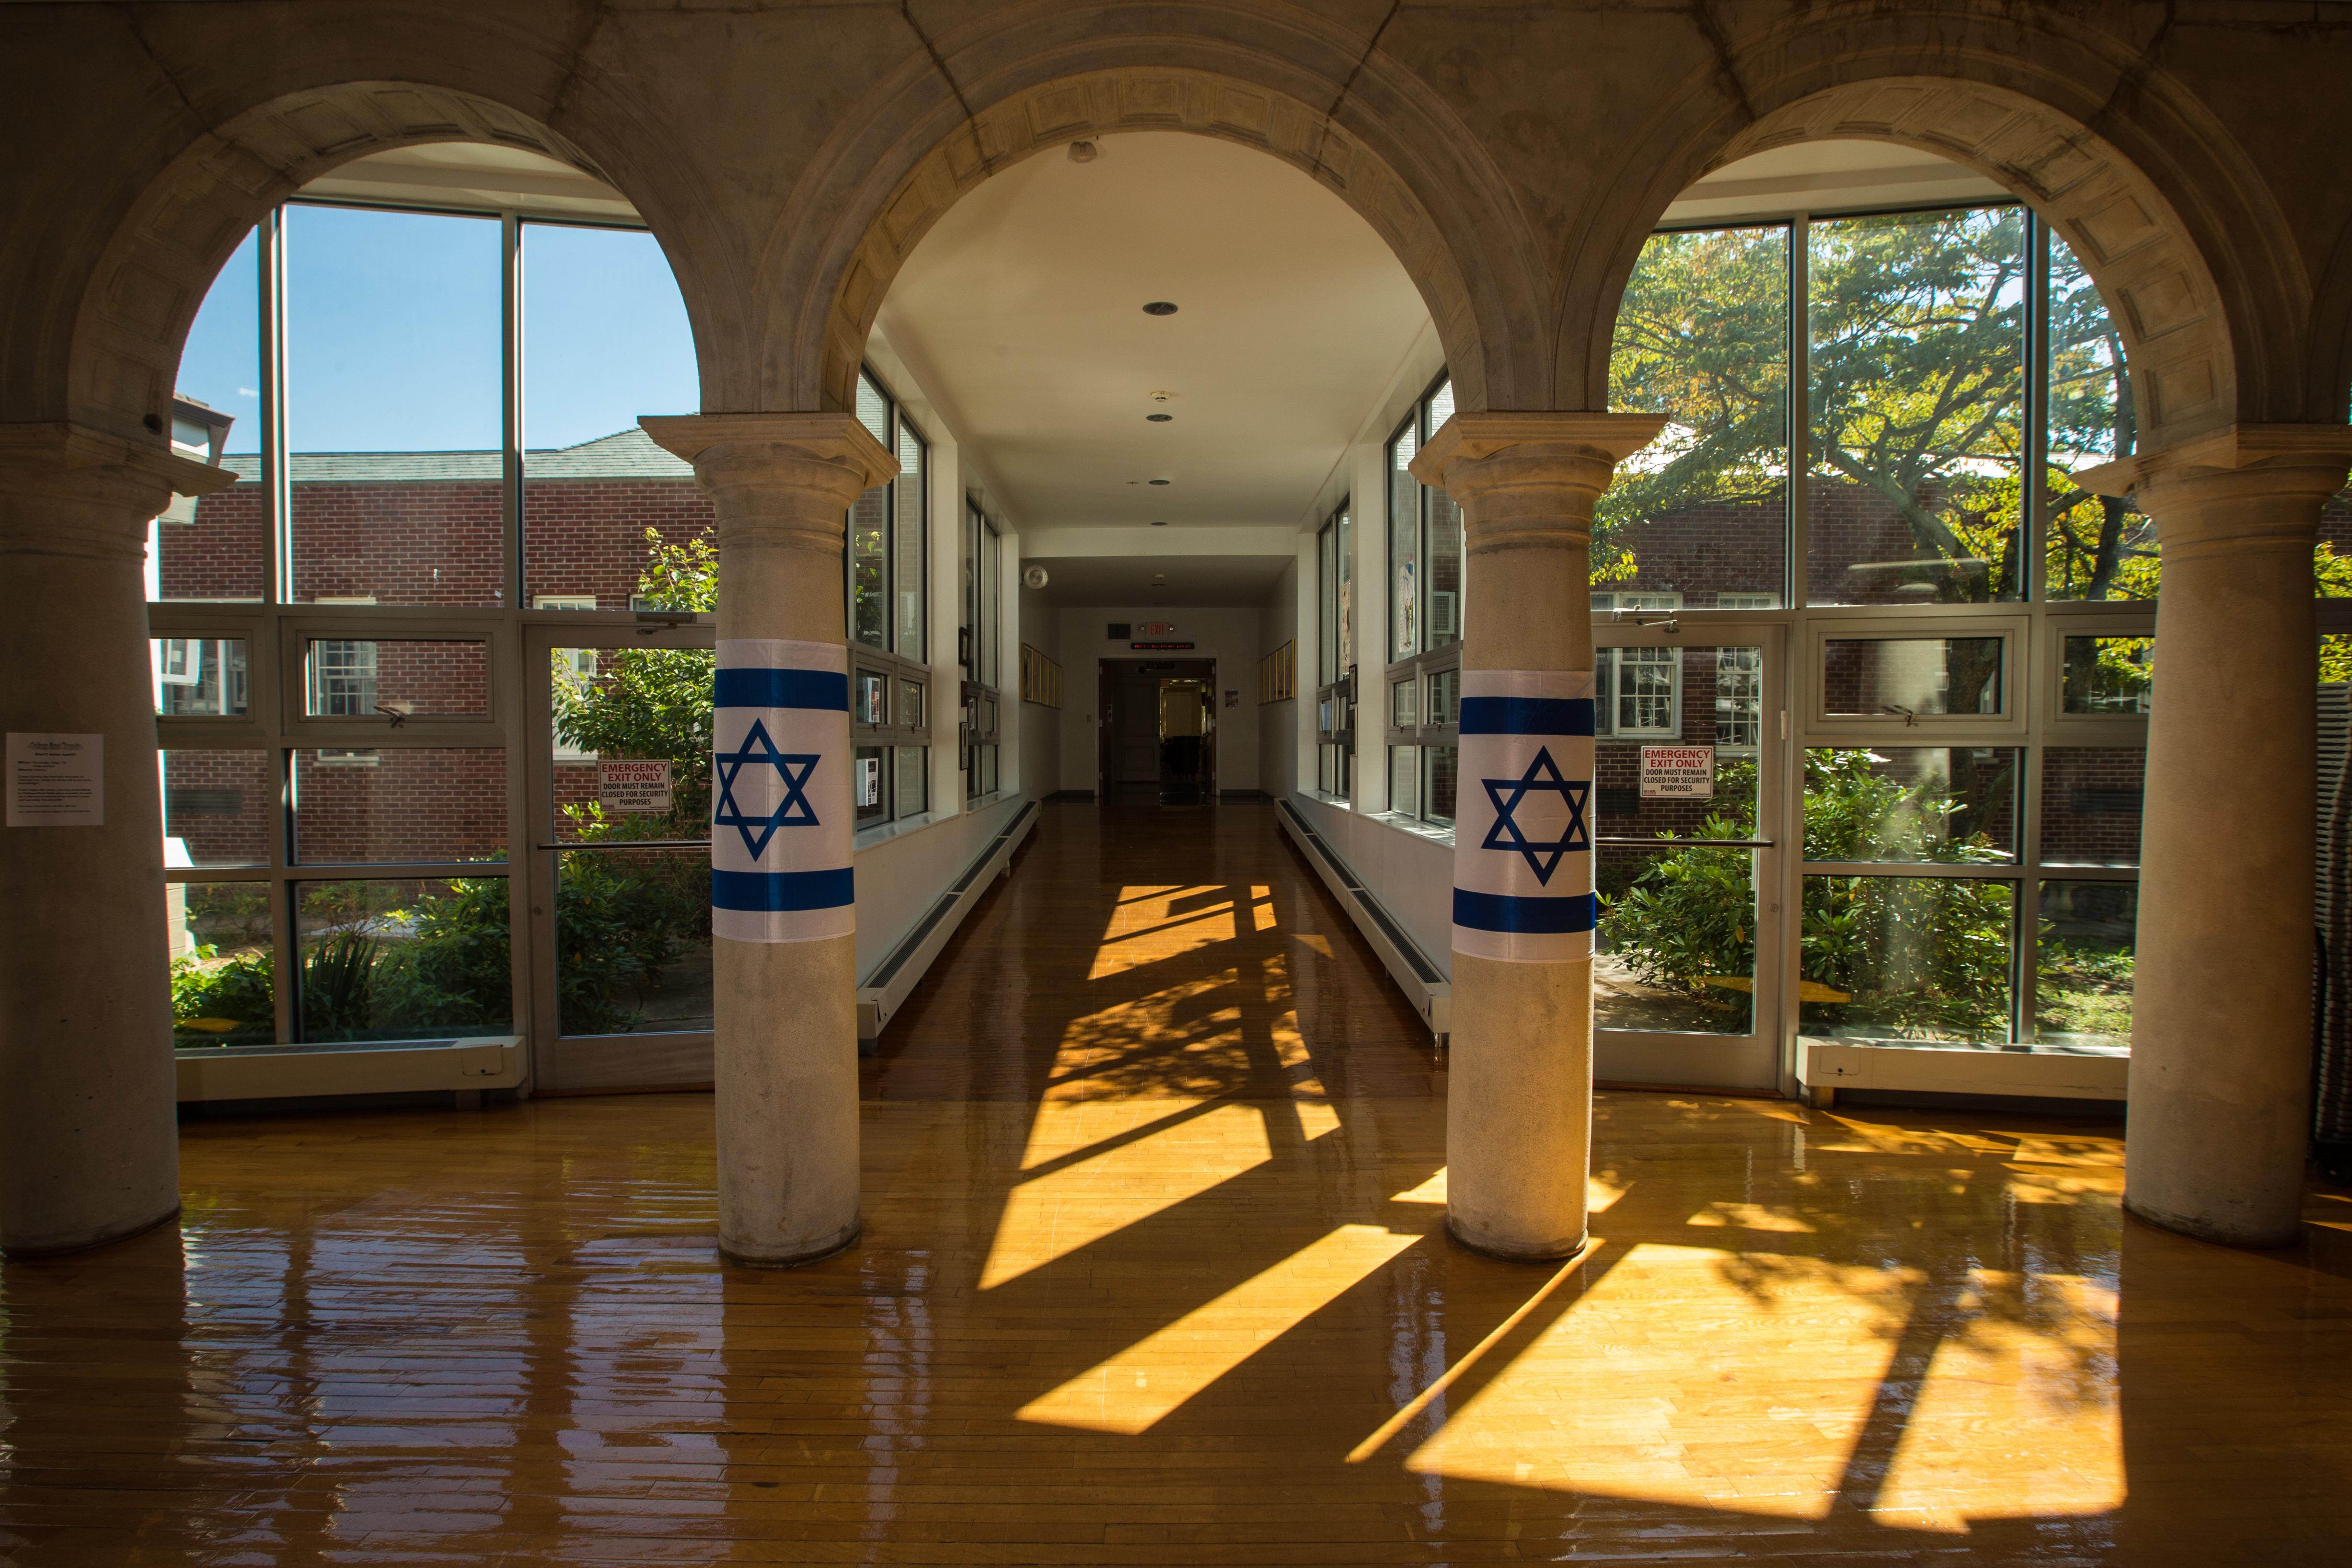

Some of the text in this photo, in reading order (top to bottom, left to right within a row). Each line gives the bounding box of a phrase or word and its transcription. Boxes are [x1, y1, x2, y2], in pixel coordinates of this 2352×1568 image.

[1150, 624, 1164, 635] EXIT
[1645, 750, 1710, 758] EMERGENCY
[602, 763, 667, 772] EMERGENCY
[1676, 759, 1704, 768] ONLY
[608, 773, 661, 782] EXIT ONLY
